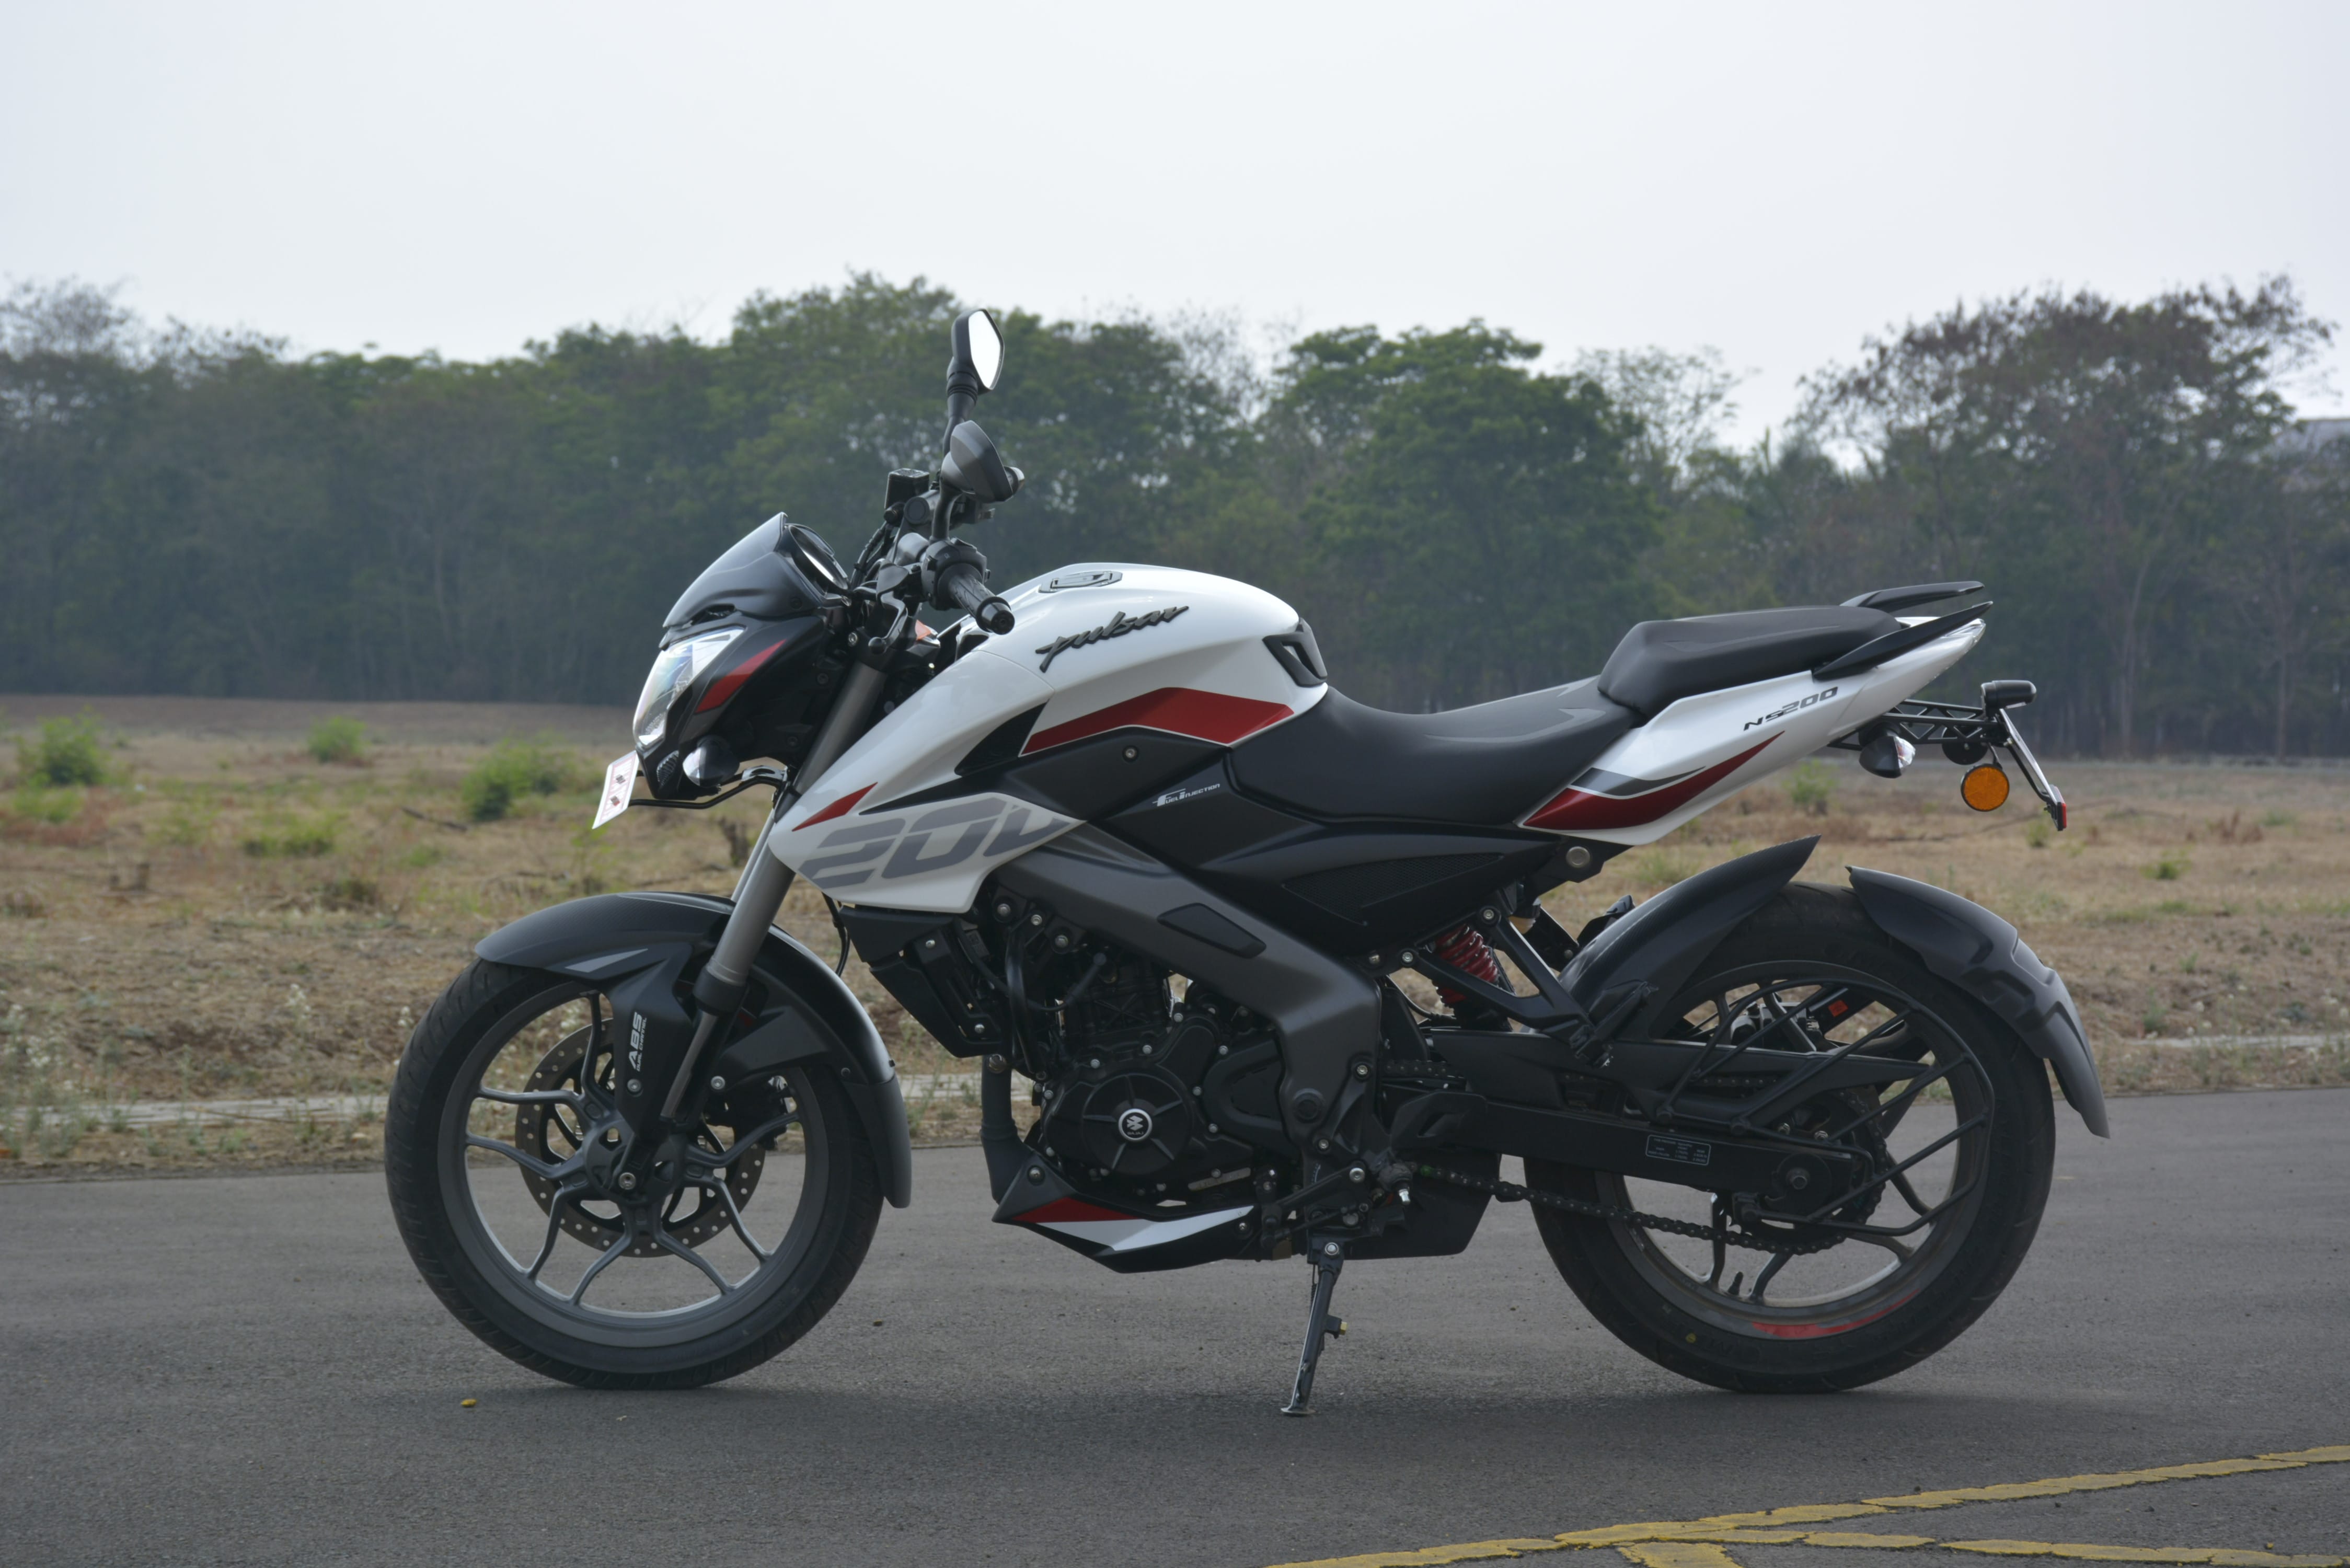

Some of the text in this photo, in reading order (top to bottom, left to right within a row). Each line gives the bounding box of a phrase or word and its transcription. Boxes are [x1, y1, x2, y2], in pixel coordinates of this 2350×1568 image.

[1035, 606, 1189, 673] pulsar
[1744, 686, 1838, 731] NS200
[629, 1011, 642, 1070] ABS
